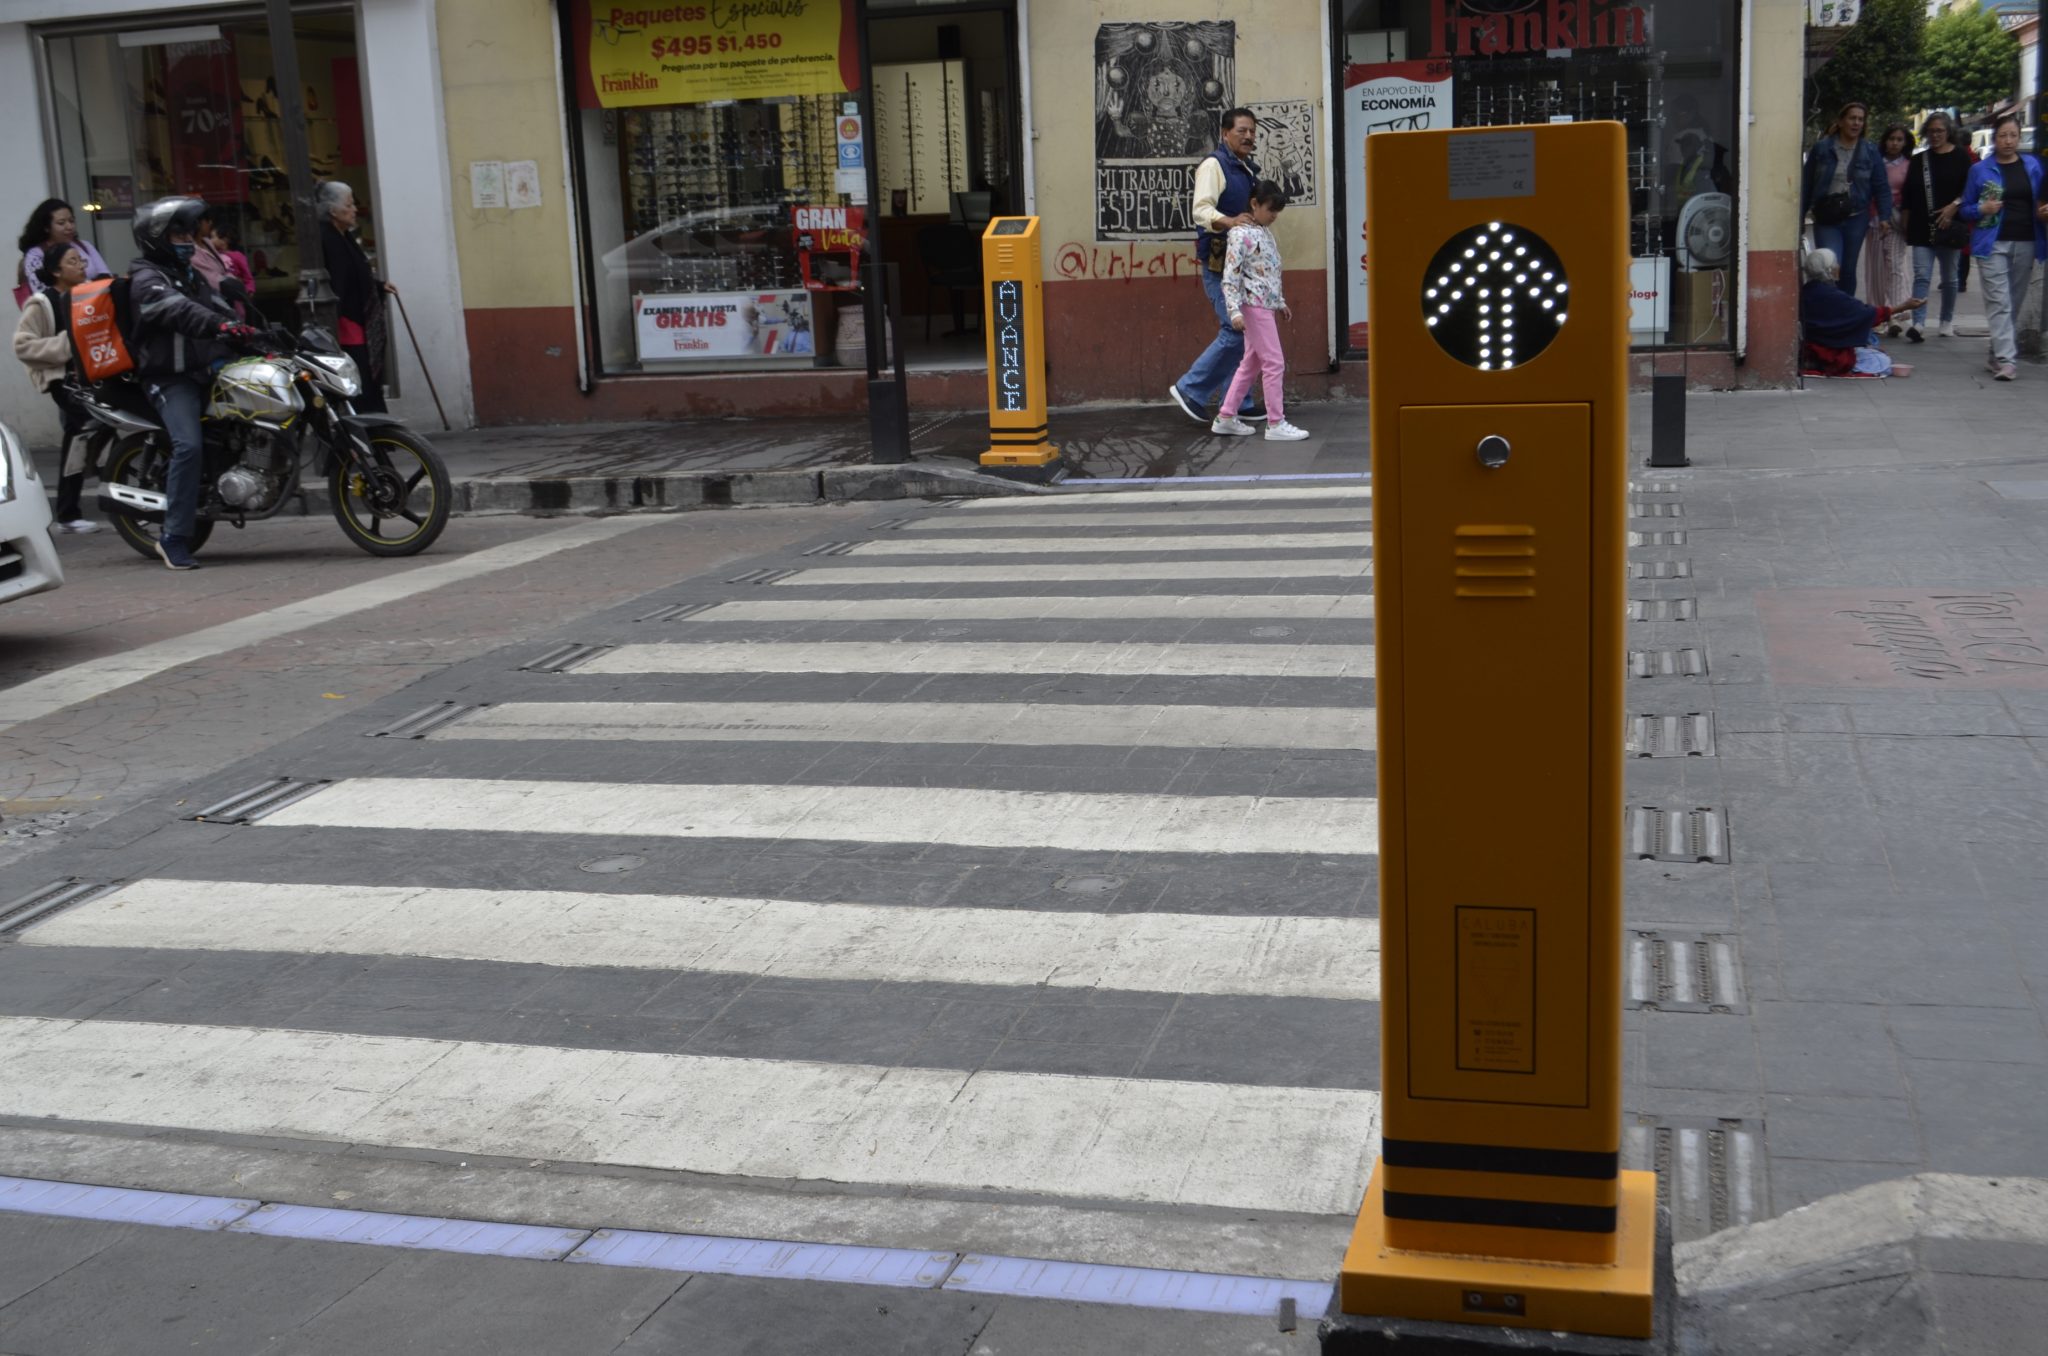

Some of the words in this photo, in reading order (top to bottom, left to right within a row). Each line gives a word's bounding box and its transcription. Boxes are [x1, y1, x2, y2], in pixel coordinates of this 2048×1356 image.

[610, 6, 706, 28] Paquetes
[709, 0, 809, 31] Especiales
[1427, 0, 1648, 57] Franklin
[651, 35, 713, 61] $495
[717, 33, 782, 55] $1,450
[661, 63, 701, 73] Pregunta
[703, 62, 718, 71] por
[730, 59, 767, 69] paquete
[768, 57, 779, 65] de
[780, 54, 835, 65] preferencia.
[600, 72, 658, 92] Franklin
[1362, 87, 1375, 97] EN
[1376, 86, 1407, 96] APOYO
[1409, 85, 1421, 95] EN
[1423, 84, 1435, 94] TU
[1361, 97, 1436, 111] ECONOMÍA
[1097, 168, 1116, 191] MI
[1118, 168, 1183, 191] TRABAJO
[796, 208, 847, 230] GRAN
[821, 228, 863, 251] Venta
[643, 307, 682, 316] EXAMEN
[684, 305, 696, 314] DE
[697, 305, 709, 314] LA
[710, 304, 738, 313] VISTA
[656, 311, 727, 329] GRATIS
[90, 341, 118, 363] 6%
[674, 338, 709, 352] Franklin
[999, 279, 1021, 412] AVANCE
